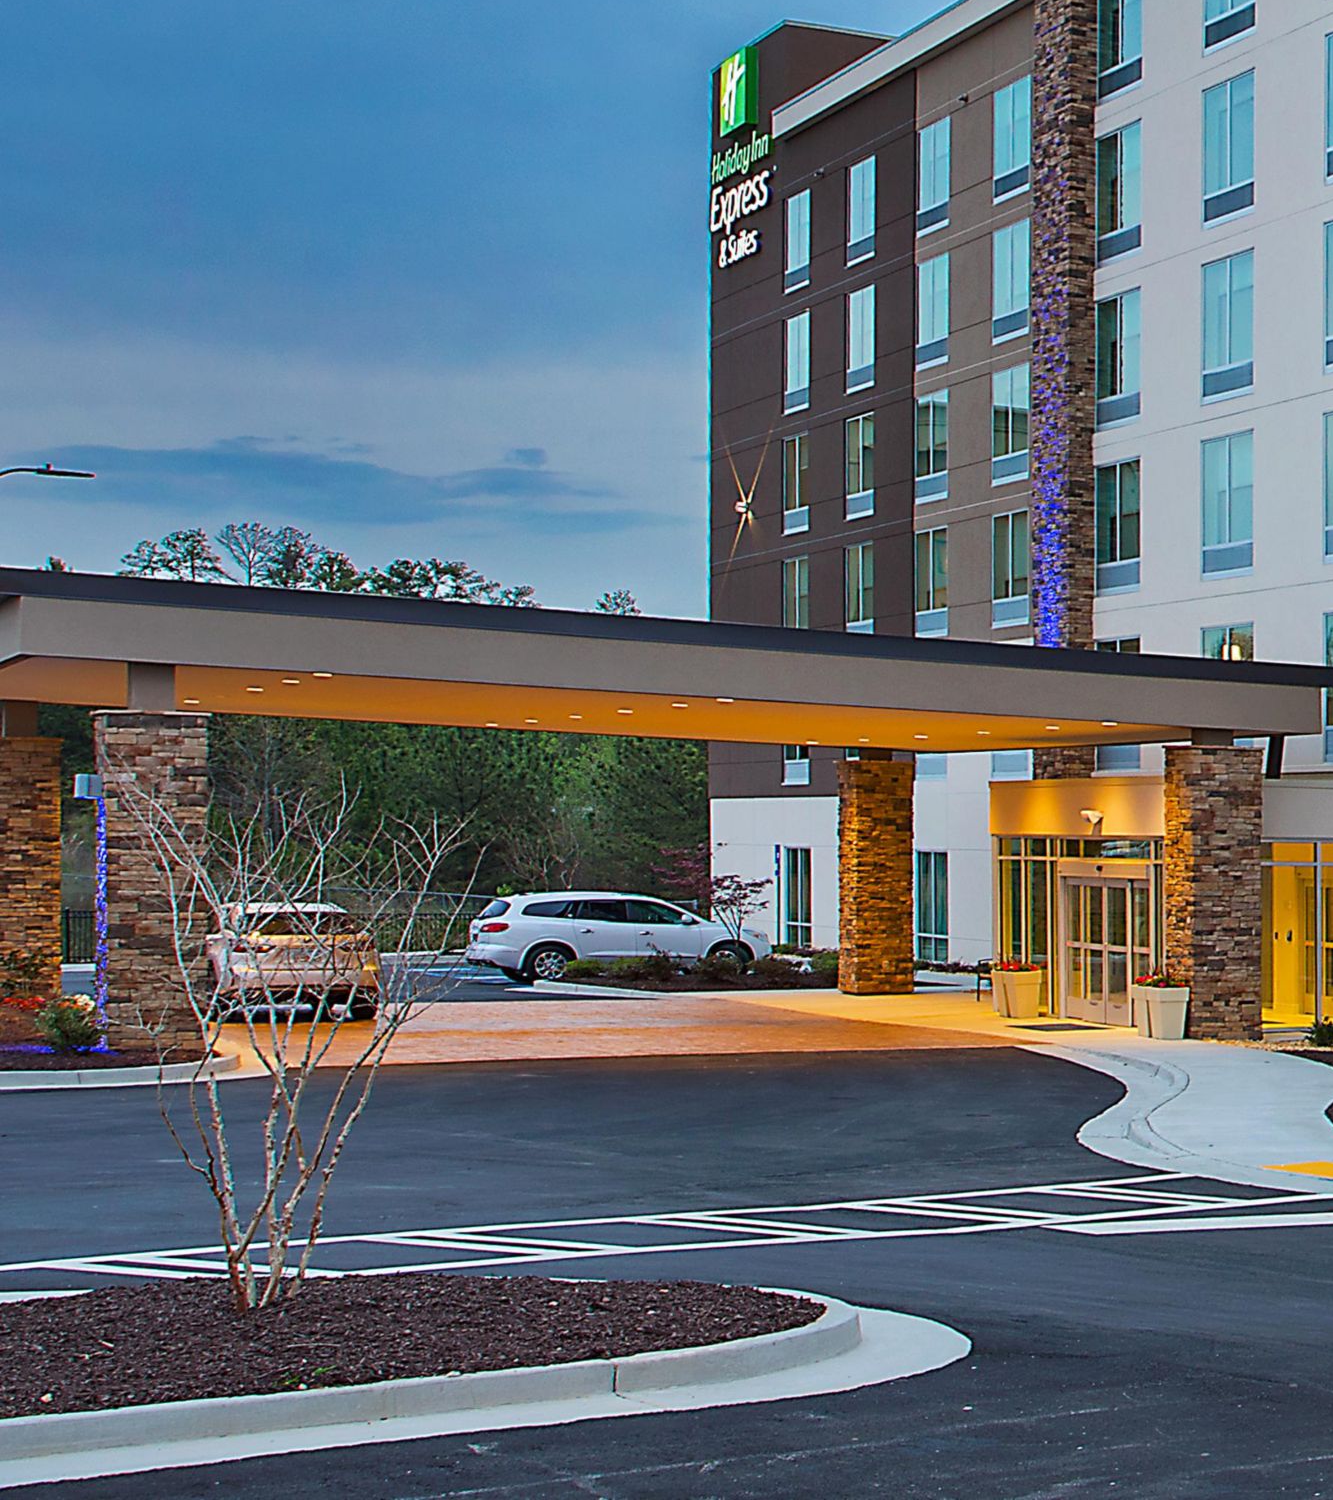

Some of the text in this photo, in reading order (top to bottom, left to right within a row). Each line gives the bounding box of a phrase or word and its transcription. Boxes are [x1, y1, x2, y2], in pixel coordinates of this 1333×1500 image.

[711, 130, 769, 184] Holiday Inn
[710, 169, 770, 234] Express
[718, 229, 759, 268] & Suites
